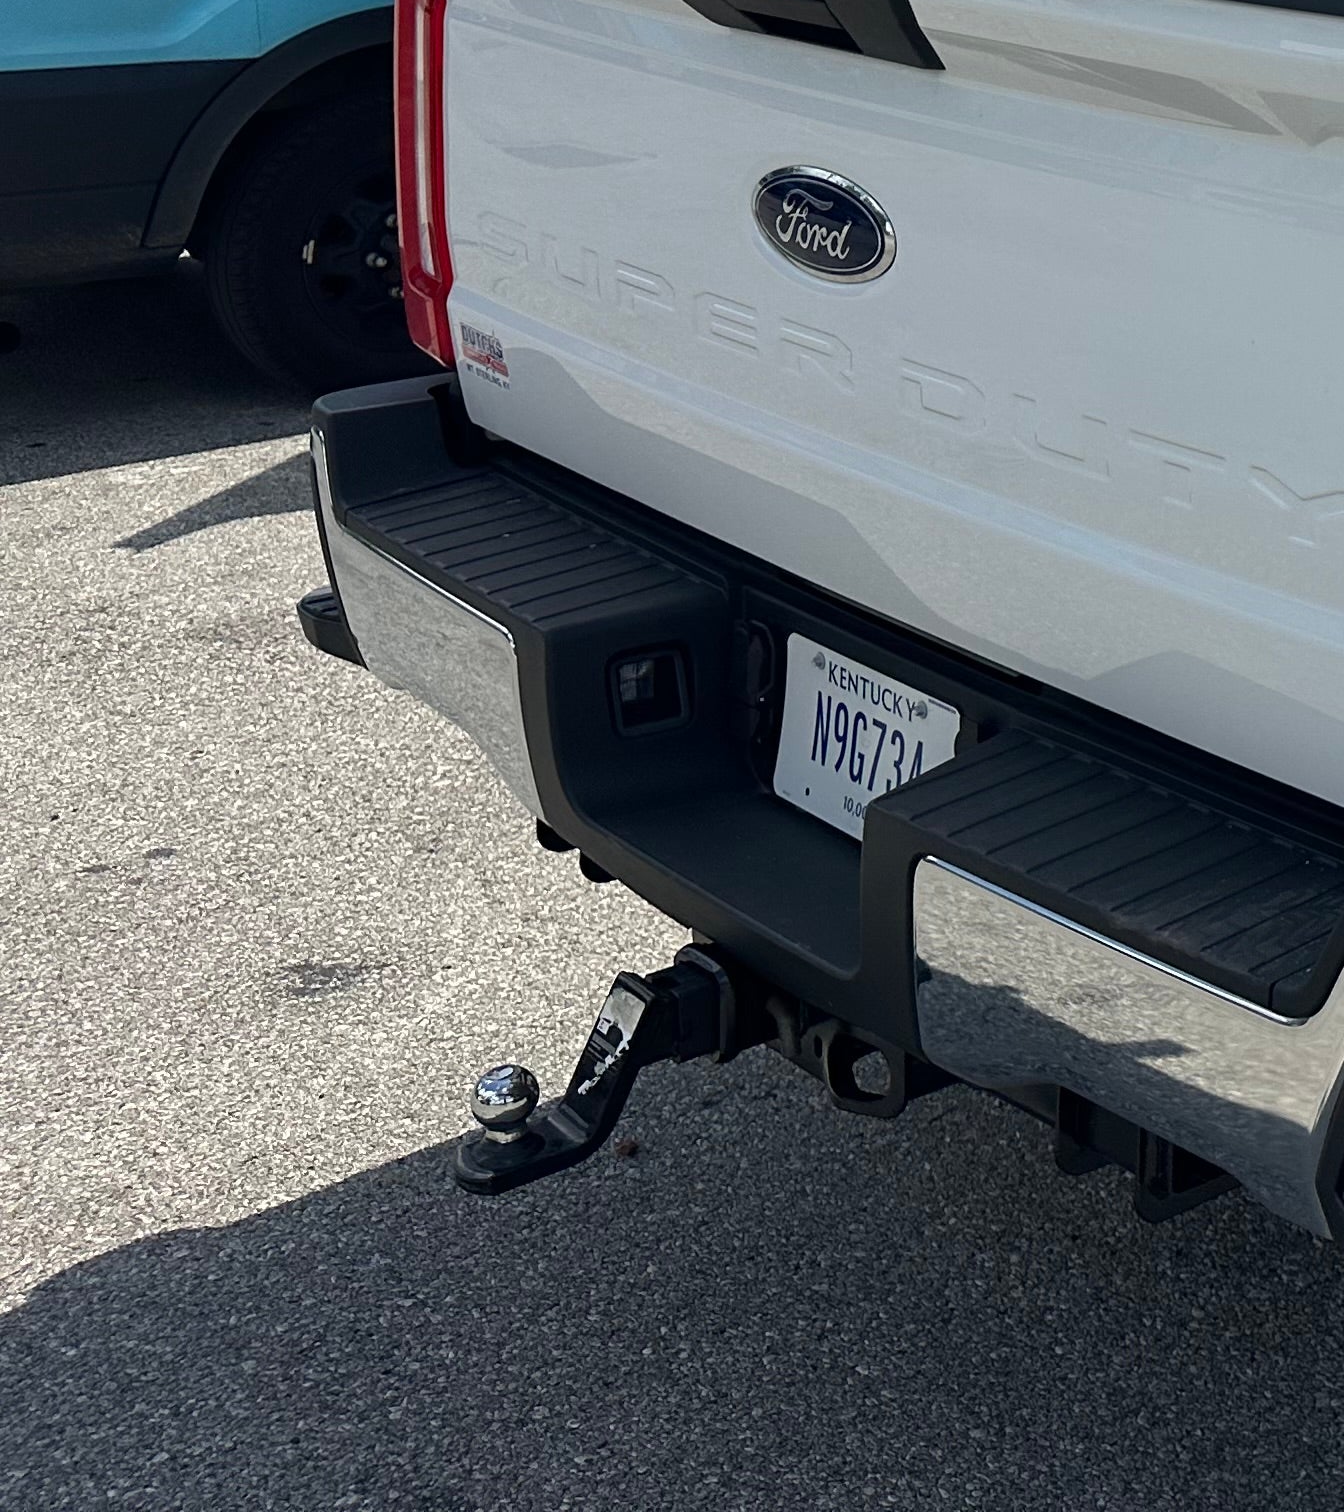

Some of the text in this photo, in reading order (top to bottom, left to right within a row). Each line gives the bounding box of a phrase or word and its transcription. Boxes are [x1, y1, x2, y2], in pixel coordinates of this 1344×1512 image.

[775, 188, 853, 260] Ford
[476, 210, 858, 395] SUPER
[828, 660, 916, 722] KENTUCKY
